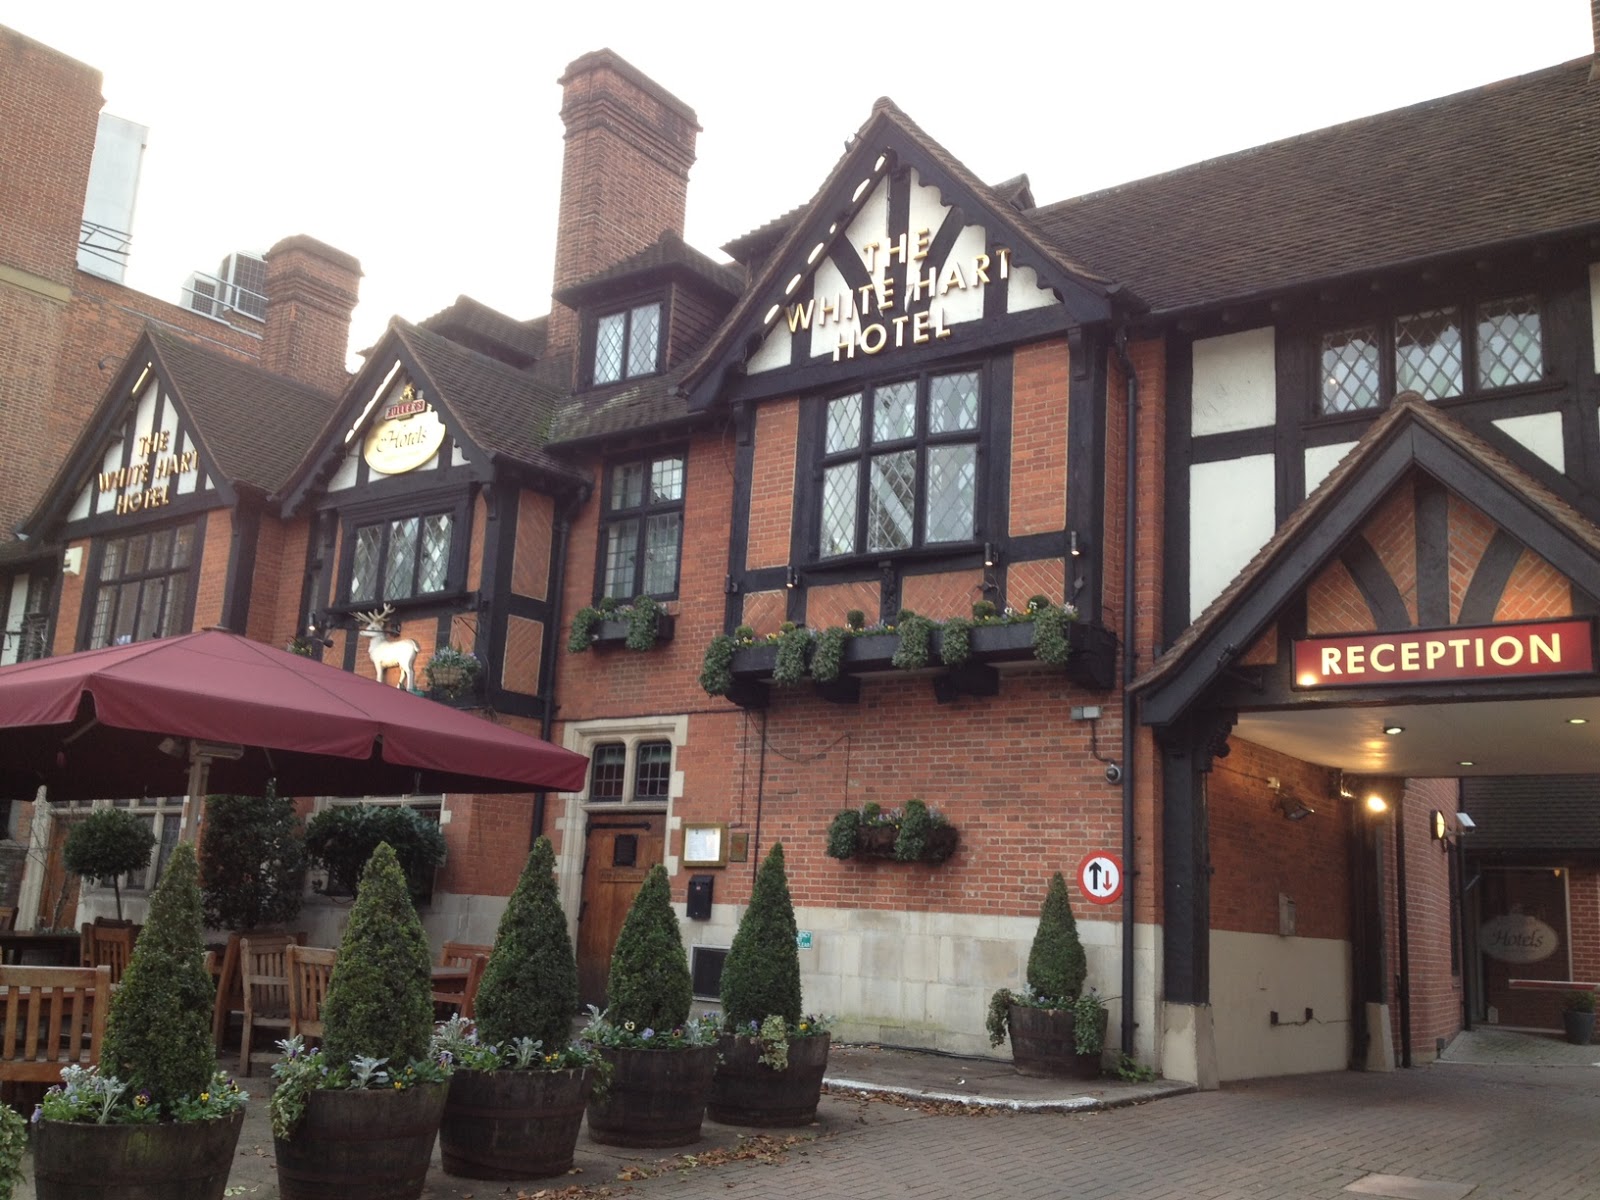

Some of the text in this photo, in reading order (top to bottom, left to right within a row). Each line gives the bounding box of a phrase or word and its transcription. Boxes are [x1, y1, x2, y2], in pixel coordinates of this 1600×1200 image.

[863, 227, 929, 273] THE
[785, 249, 1011, 333] WHITE HART
[832, 307, 951, 362] HOTEL
[139, 430, 170, 457] THE
[98, 450, 199, 493] WHITE HART
[116, 484, 170, 515] HOTEL
[1321, 632, 1562, 676] RECEPTION
[1488, 928, 1544, 948] Hotels
